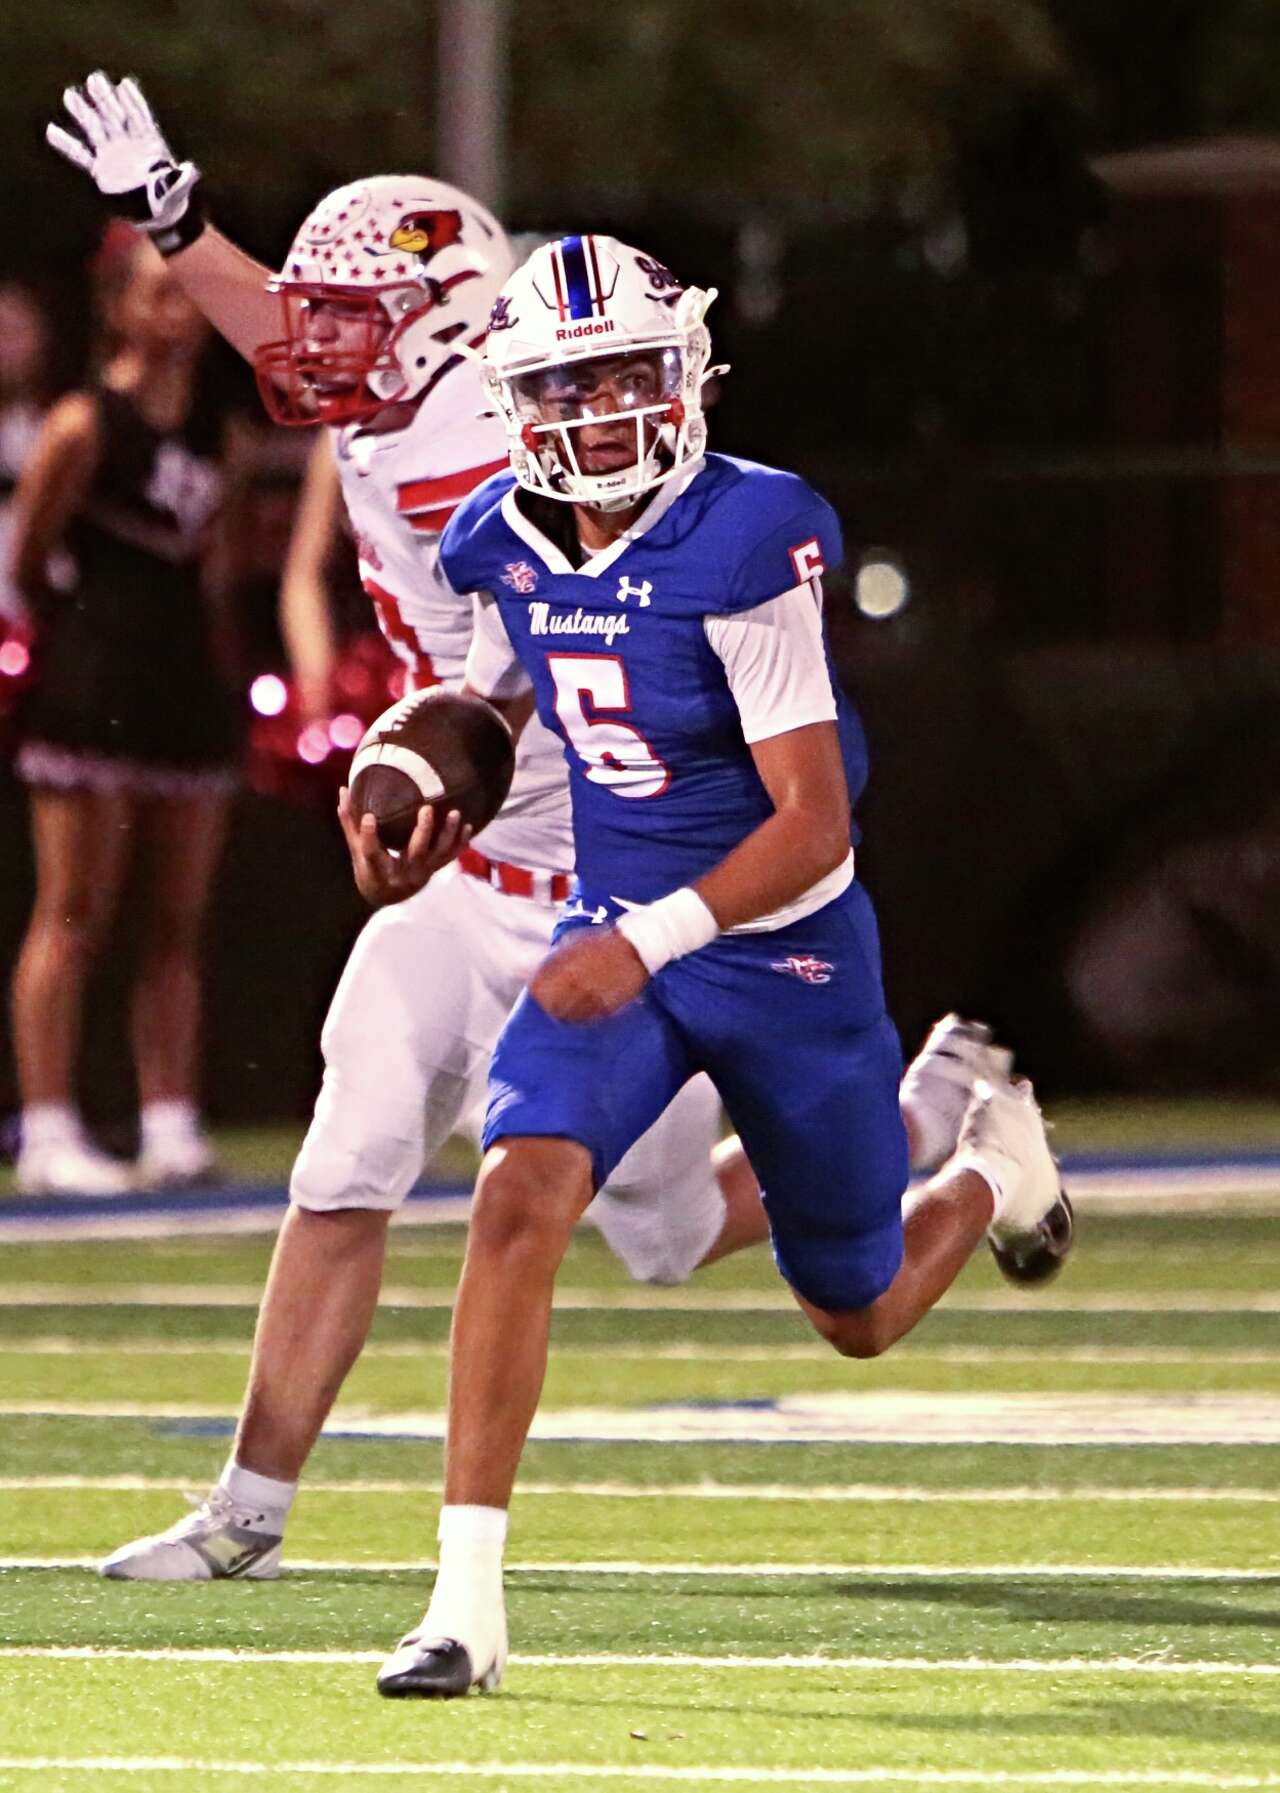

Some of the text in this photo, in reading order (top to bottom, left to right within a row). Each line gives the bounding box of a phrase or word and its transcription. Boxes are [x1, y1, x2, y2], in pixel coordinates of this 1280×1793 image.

[556, 319, 614, 341] Riddell
[528, 602, 630, 646] Mustangs
[545, 652, 672, 799] 6
